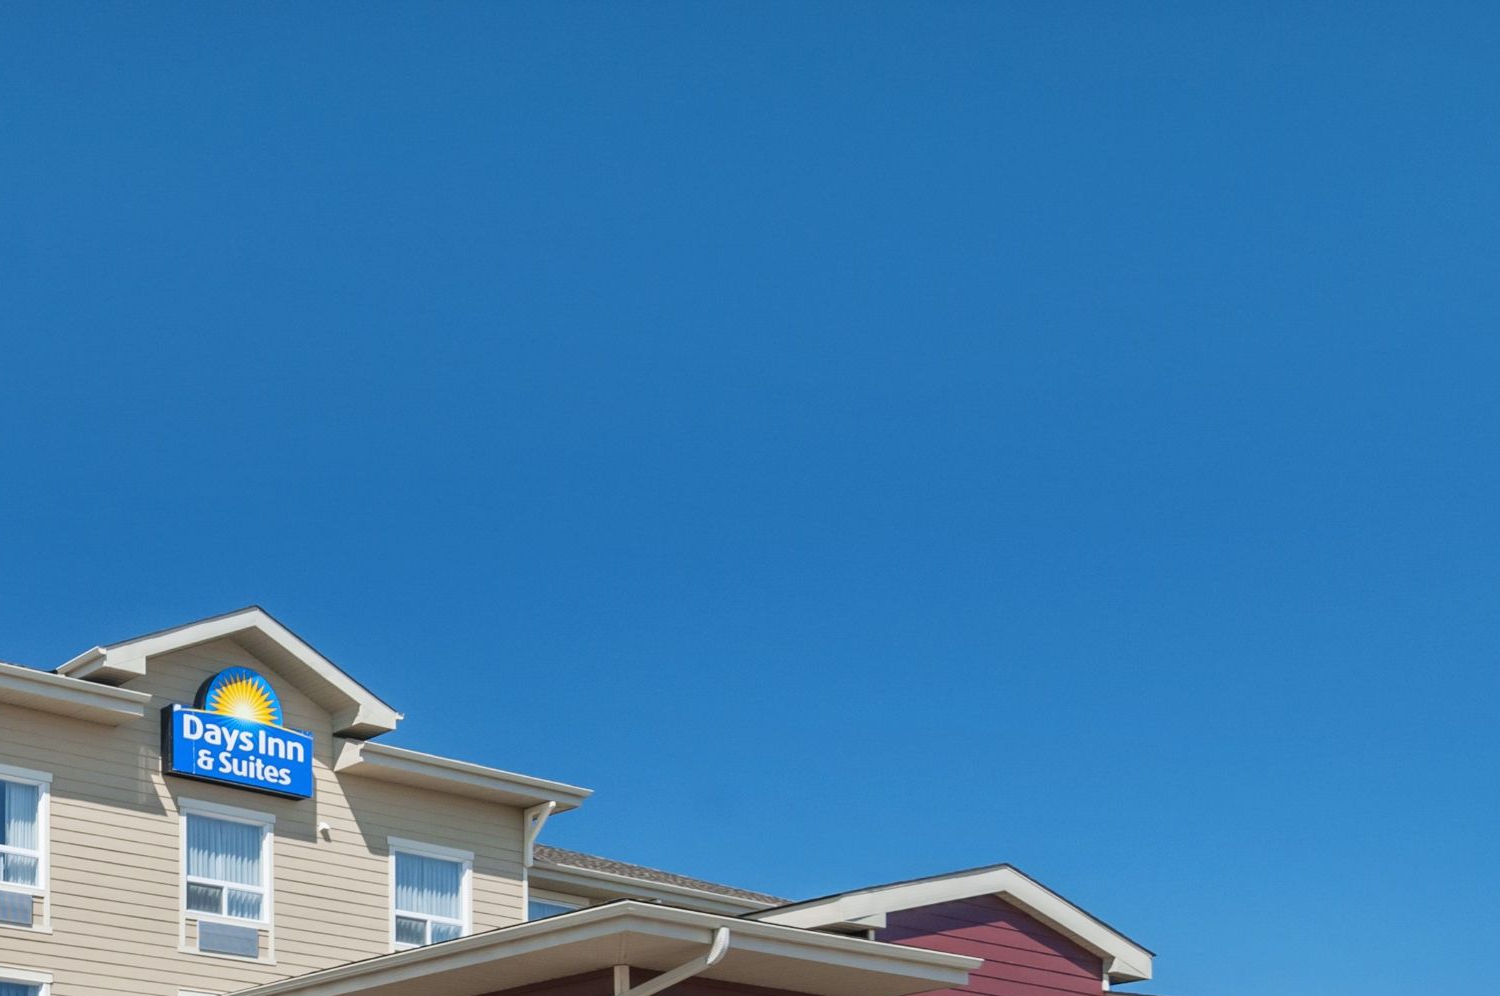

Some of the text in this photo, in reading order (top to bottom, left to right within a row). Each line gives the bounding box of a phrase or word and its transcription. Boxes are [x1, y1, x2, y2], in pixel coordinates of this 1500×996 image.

[183, 714, 304, 763] Days Inn
[197, 749, 292, 785] & Suites
